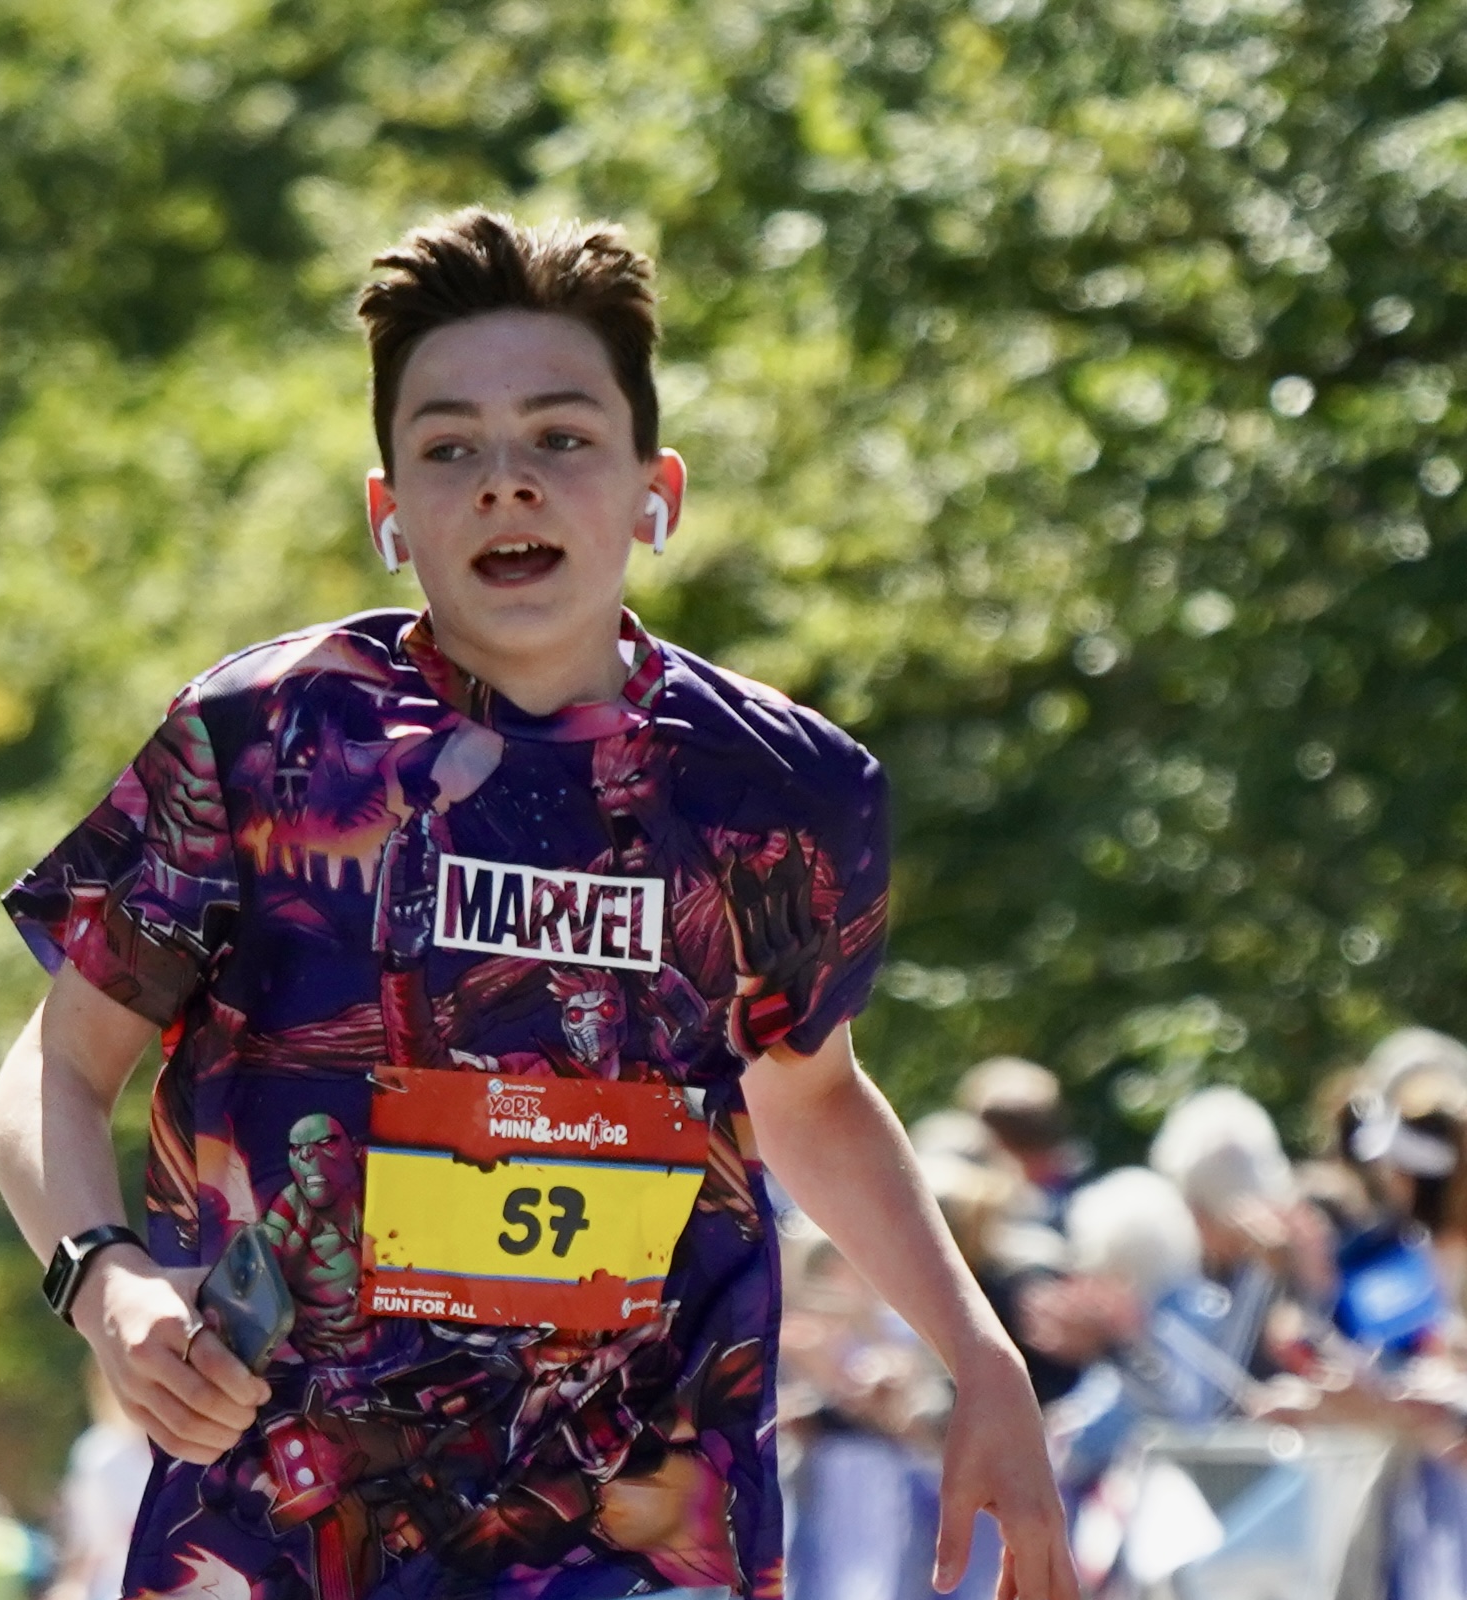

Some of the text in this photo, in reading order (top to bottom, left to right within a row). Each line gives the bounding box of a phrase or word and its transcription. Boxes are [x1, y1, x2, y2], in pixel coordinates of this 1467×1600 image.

[442, 862, 655, 964] MARVEL
[487, 1094, 541, 1119] YORK
[497, 1185, 591, 1258] 57
[412, 1298, 446, 1315] FOR
[449, 1302, 478, 1319] ALL
